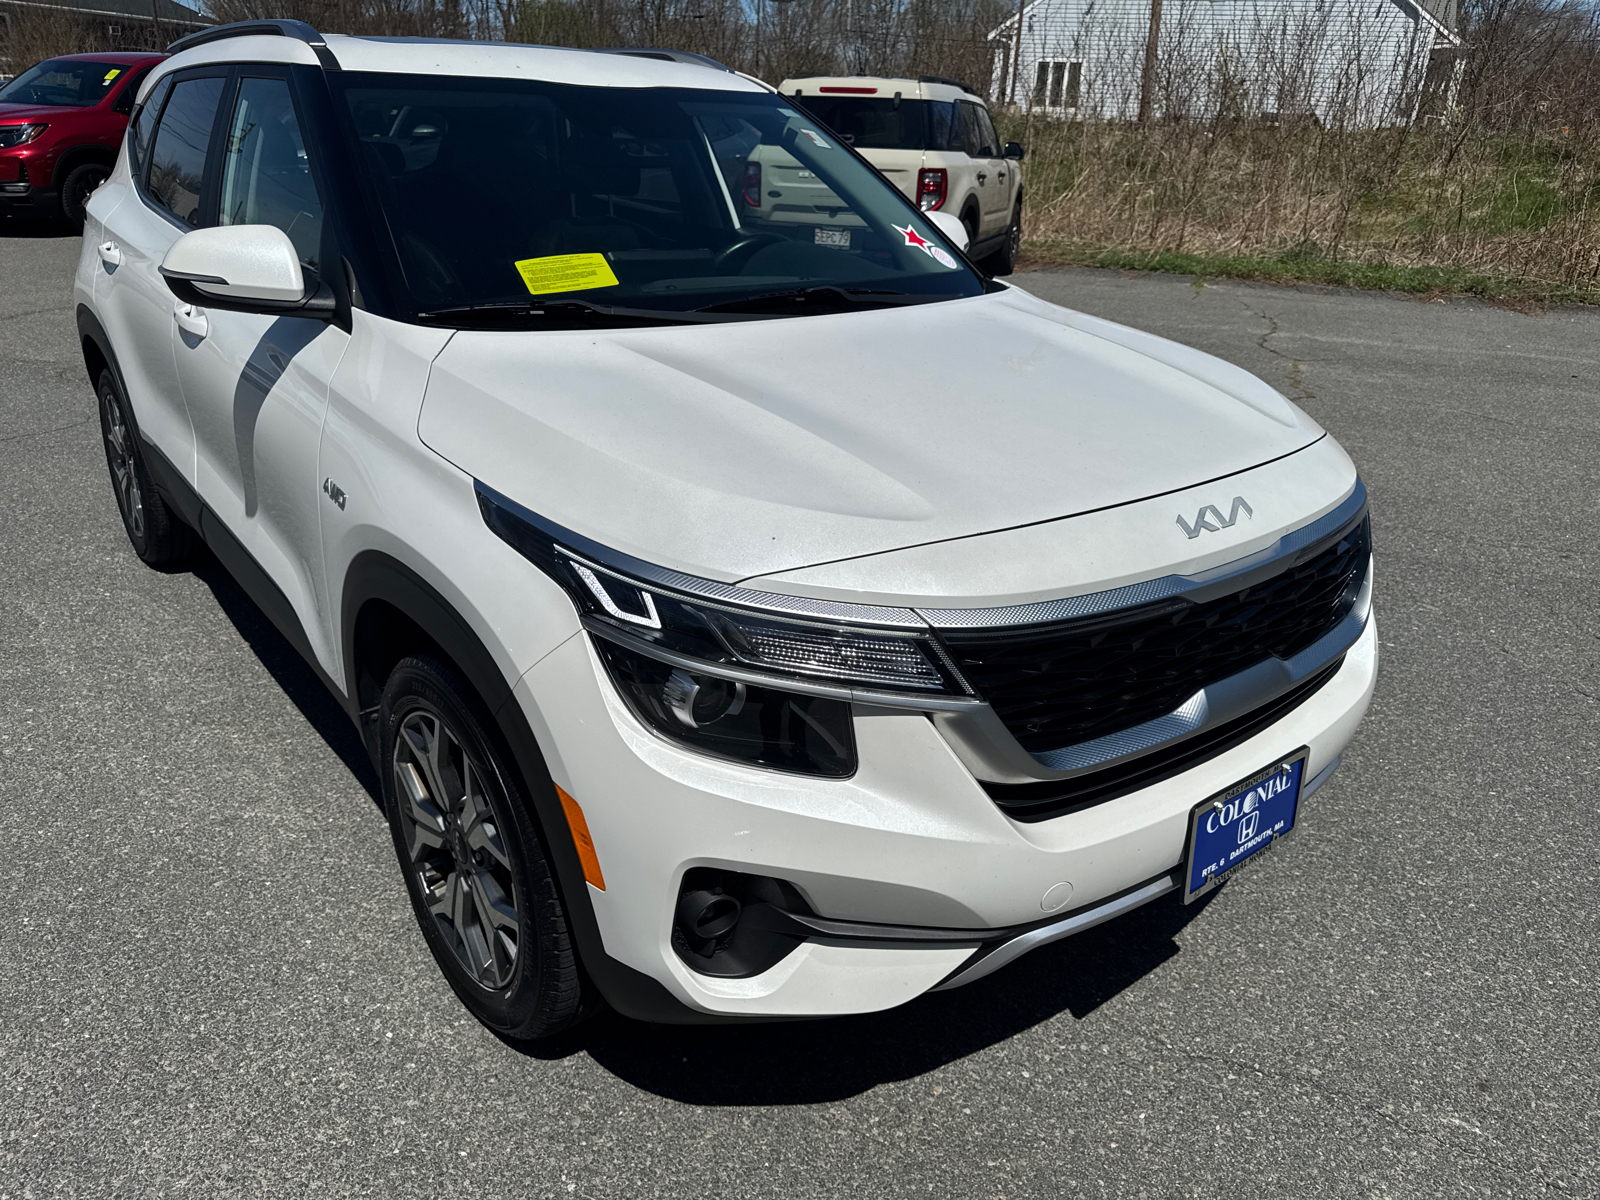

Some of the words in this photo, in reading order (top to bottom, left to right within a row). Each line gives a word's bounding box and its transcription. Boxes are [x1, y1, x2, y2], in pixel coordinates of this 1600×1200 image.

[1176, 495, 1253, 540] KIA
[1206, 775, 1292, 834] COLONIAL
[1201, 862, 1218, 878] RTE.
[1219, 857, 1226, 867] 6
[1229, 827, 1273, 860] DARTMOUTH,
[1273, 819, 1285, 832] MA
